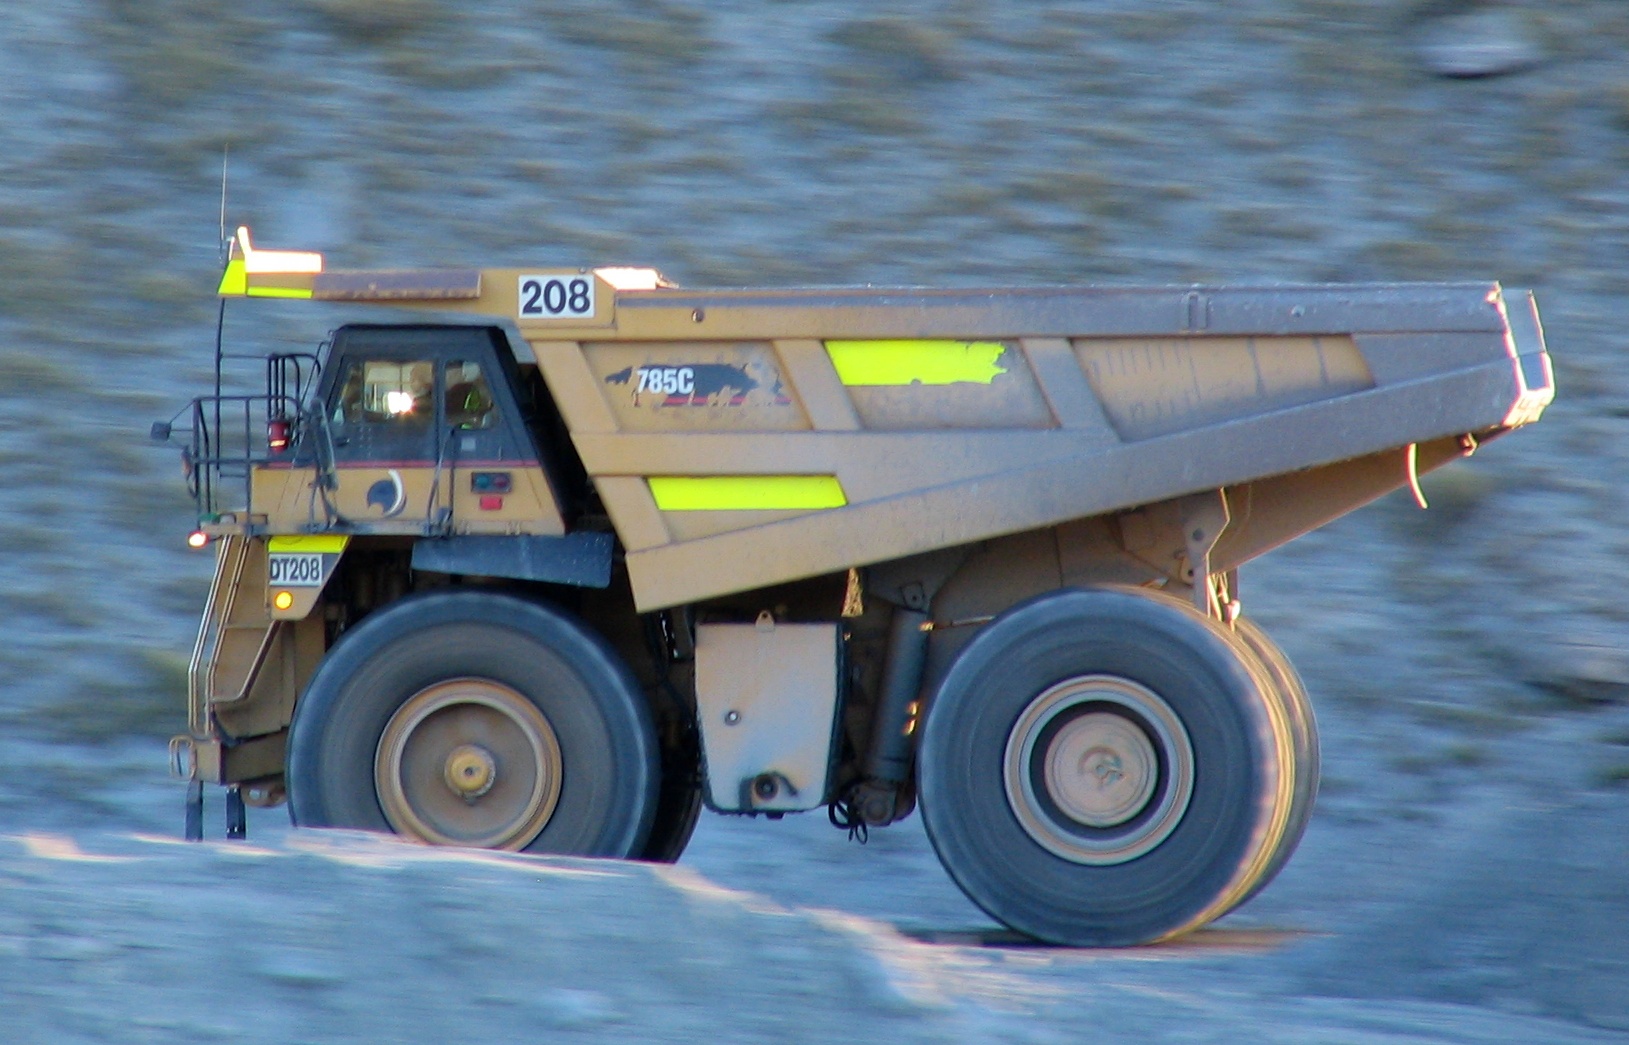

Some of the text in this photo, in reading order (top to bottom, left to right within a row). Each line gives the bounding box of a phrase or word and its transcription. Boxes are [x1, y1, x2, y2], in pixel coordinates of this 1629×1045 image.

[522, 279, 590, 314] 208
[637, 367, 695, 395] 785C
[270, 557, 320, 580] DT208
